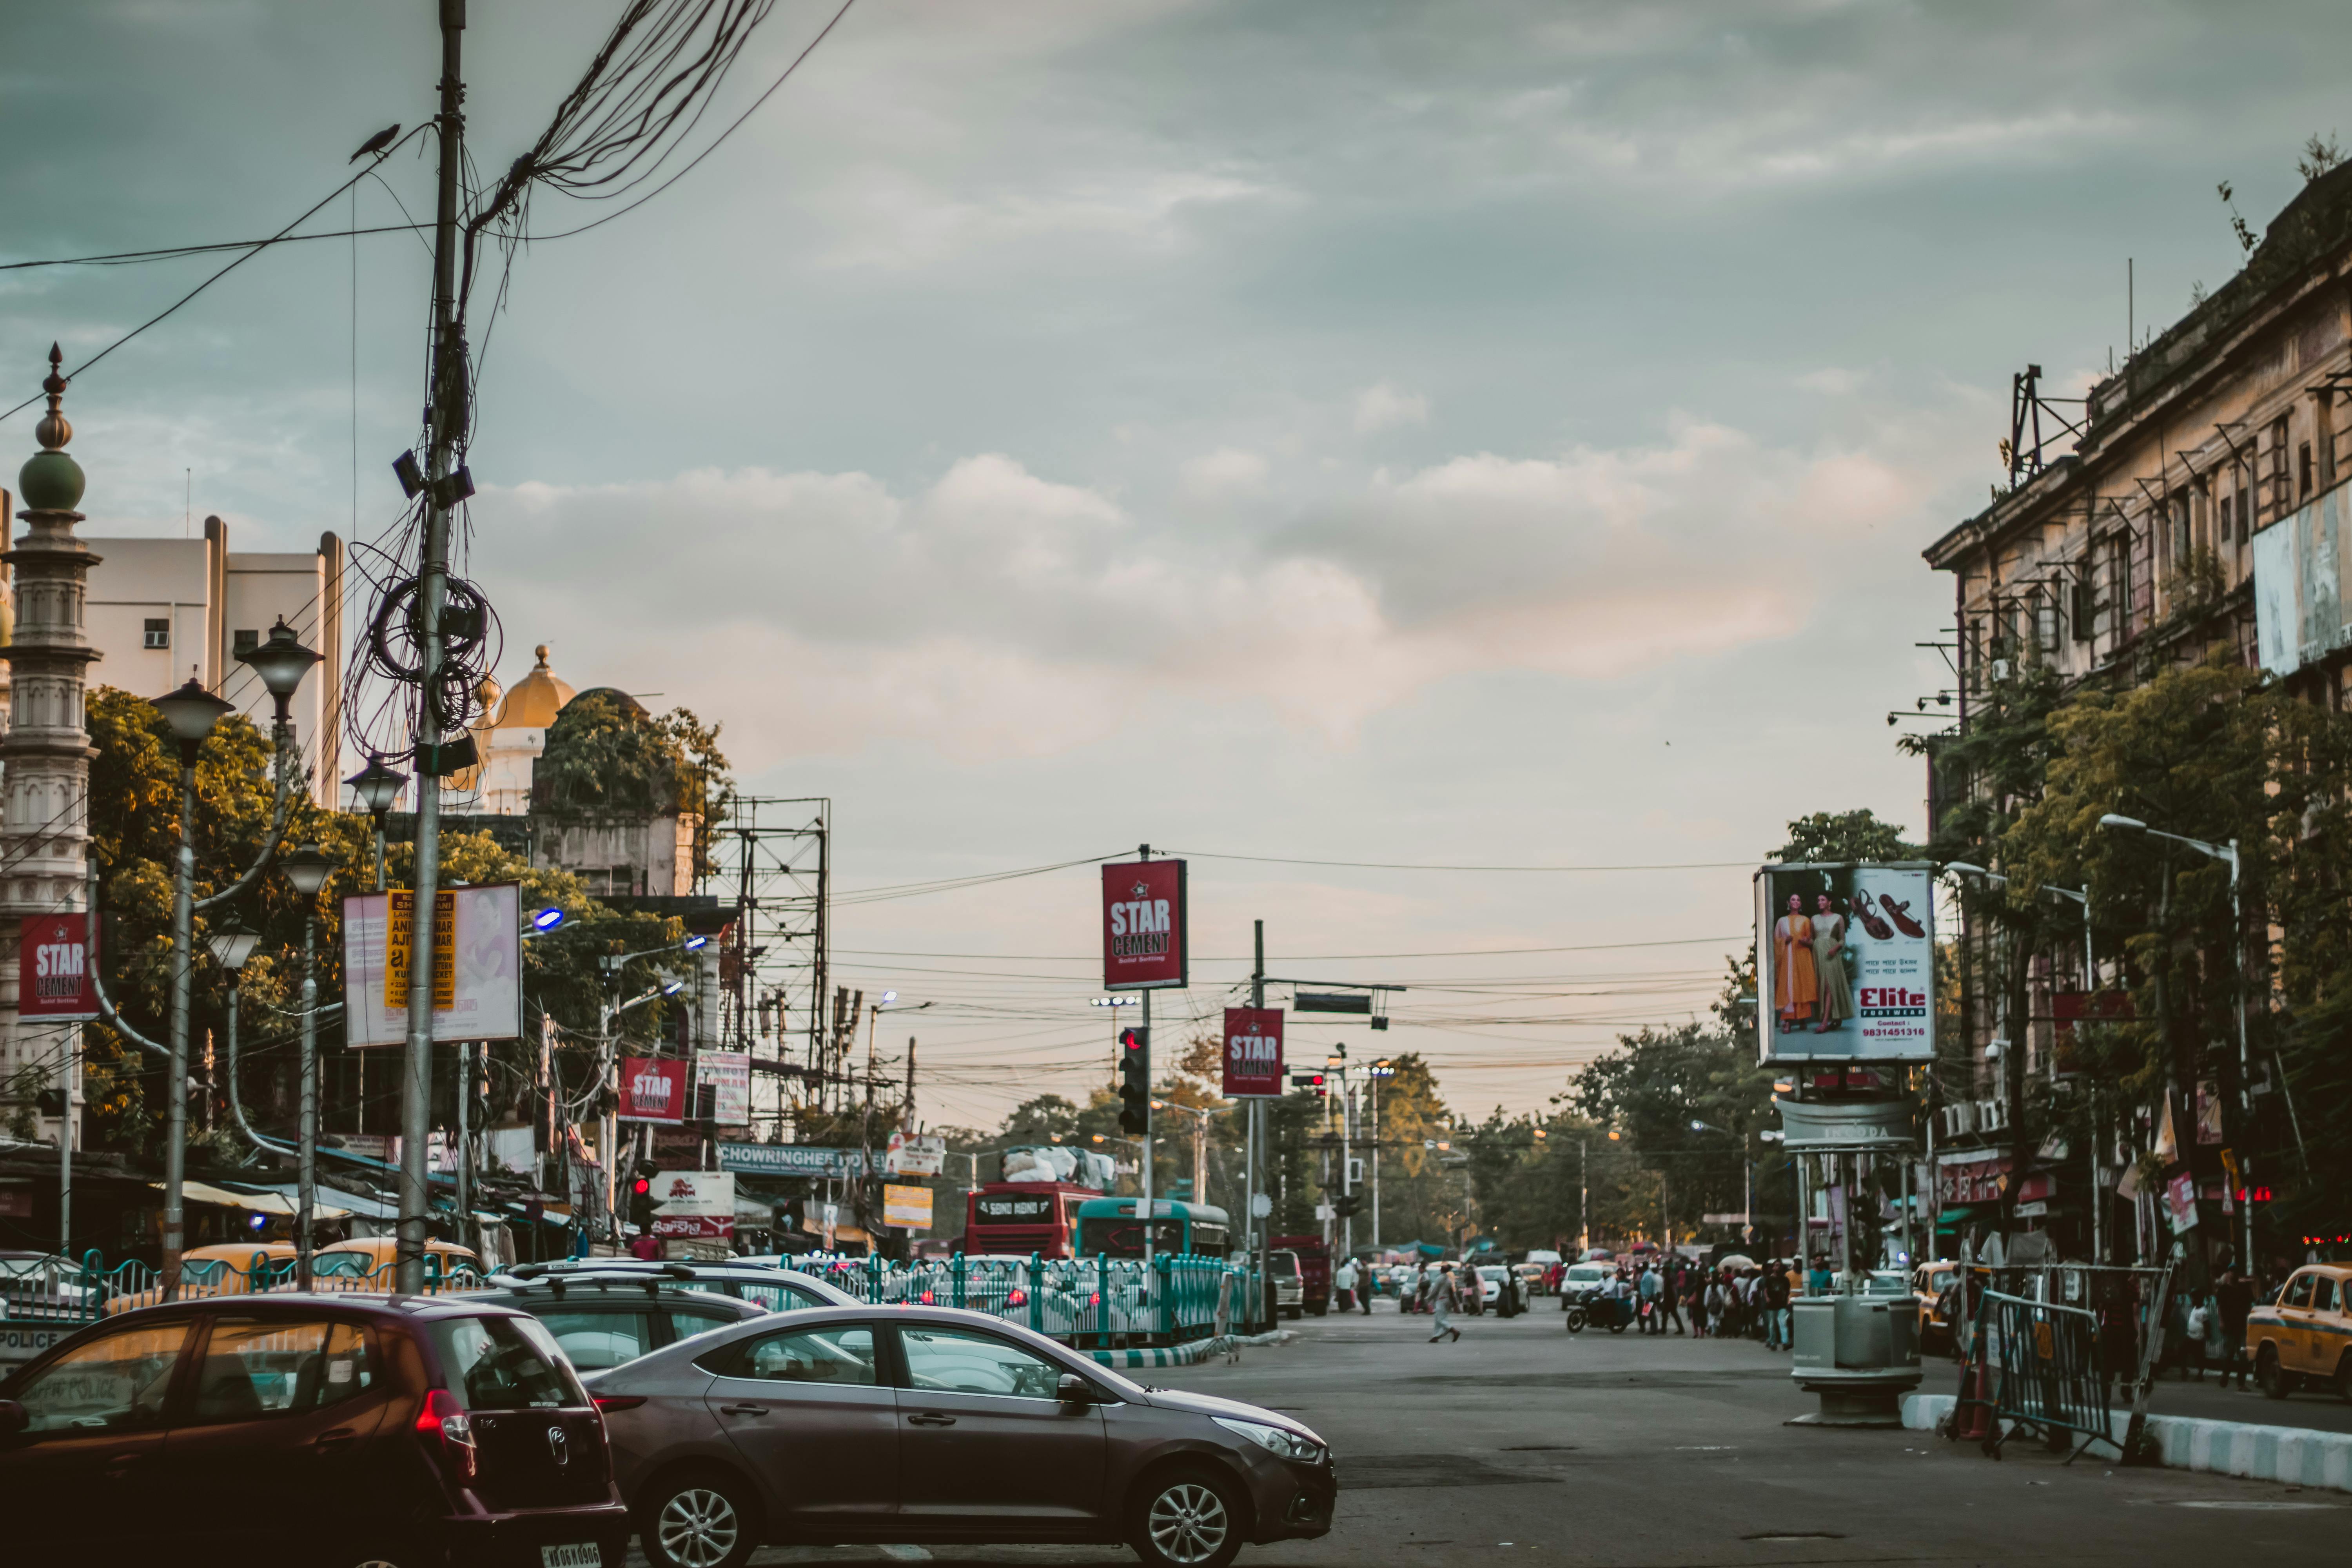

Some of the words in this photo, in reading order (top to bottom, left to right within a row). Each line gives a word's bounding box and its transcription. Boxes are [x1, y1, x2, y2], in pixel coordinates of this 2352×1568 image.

[392, 920, 412, 932] ANI
[435, 920, 452, 933] MAR
[1111, 899, 1170, 935] STAR
[392, 934, 412, 946] AJI
[434, 934, 452, 946] MAR
[1112, 933, 1170, 956] CEMENT
[36, 943, 83, 976] STAR
[36, 976, 83, 997] CEMENT
[1860, 987, 1926, 1007] Elite
[1230, 1035, 1277, 1060] STAR
[1231, 1060, 1276, 1075] CEMENT
[633, 1074, 671, 1096] STAR
[633, 1094, 670, 1109] CEMENT
[721, 1147, 835, 1167] CHOWRINGHEE
[577, 1547, 599, 1564] 0906
